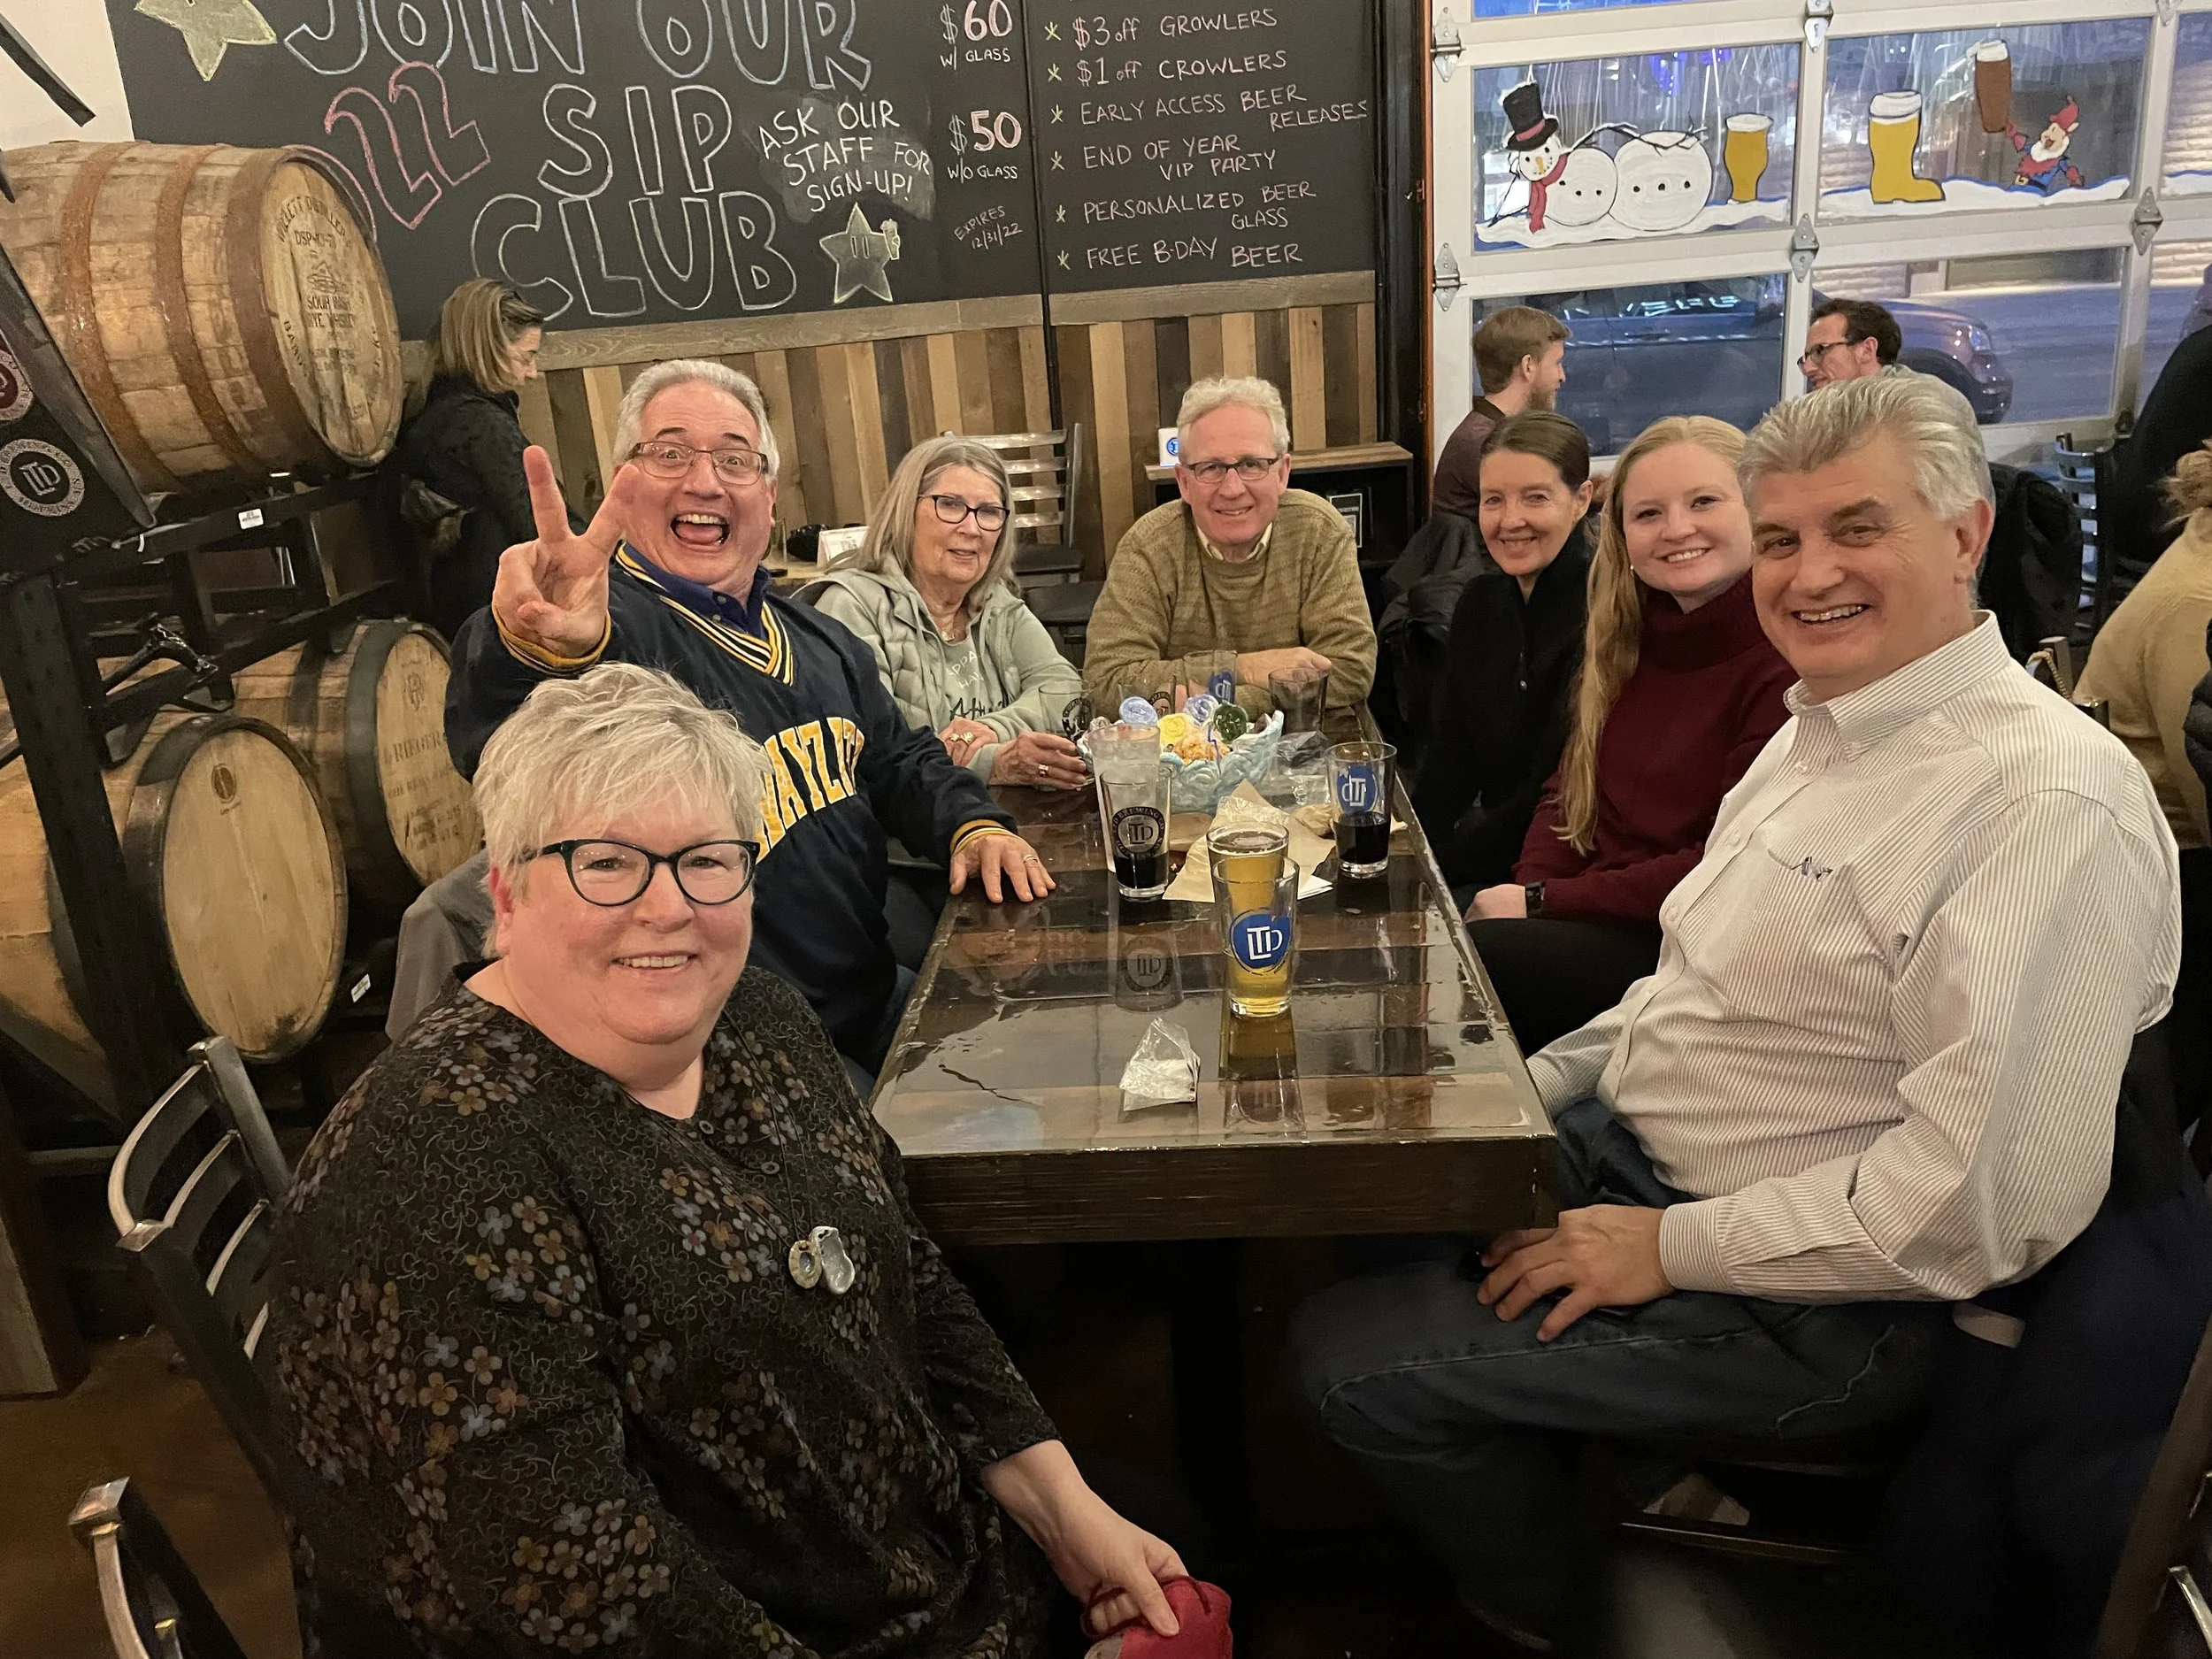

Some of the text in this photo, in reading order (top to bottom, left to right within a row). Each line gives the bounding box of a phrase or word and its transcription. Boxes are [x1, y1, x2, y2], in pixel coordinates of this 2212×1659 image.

[941, 0, 1013, 44] $60
[1160, 8, 1278, 38] GROWLERS
[283, 0, 872, 90] JOIN OUR
[965, 47, 1011, 63] GLASS
[1158, 50, 1286, 81] CROWLERS
[1080, 83, 1308, 125] EARLY ACCESS BEER
[1270, 99, 1368, 133] RELEASES
[537, 83, 732, 198] SIP
[758, 99, 901, 160] ASK OUR
[949, 109, 1022, 156] $50
[783, 136, 930, 187] STAFF FOR
[1083, 134, 1240, 169] END OF YEAR
[1160, 149, 1276, 181] VIP PARTY
[807, 169, 913, 212] SIGN-UP!
[977, 165, 1018, 180] GLASS
[1083, 180, 1317, 224] PERSONALIZED BEER
[1231, 207, 1289, 230] GLASS
[954, 205, 1006, 241] EXPIRES
[972, 222, 1024, 250] 12/31/22
[471, 191, 797, 321] CLUB
[1087, 243, 1142, 269] FREE
[1231, 243, 1303, 267] BEER
